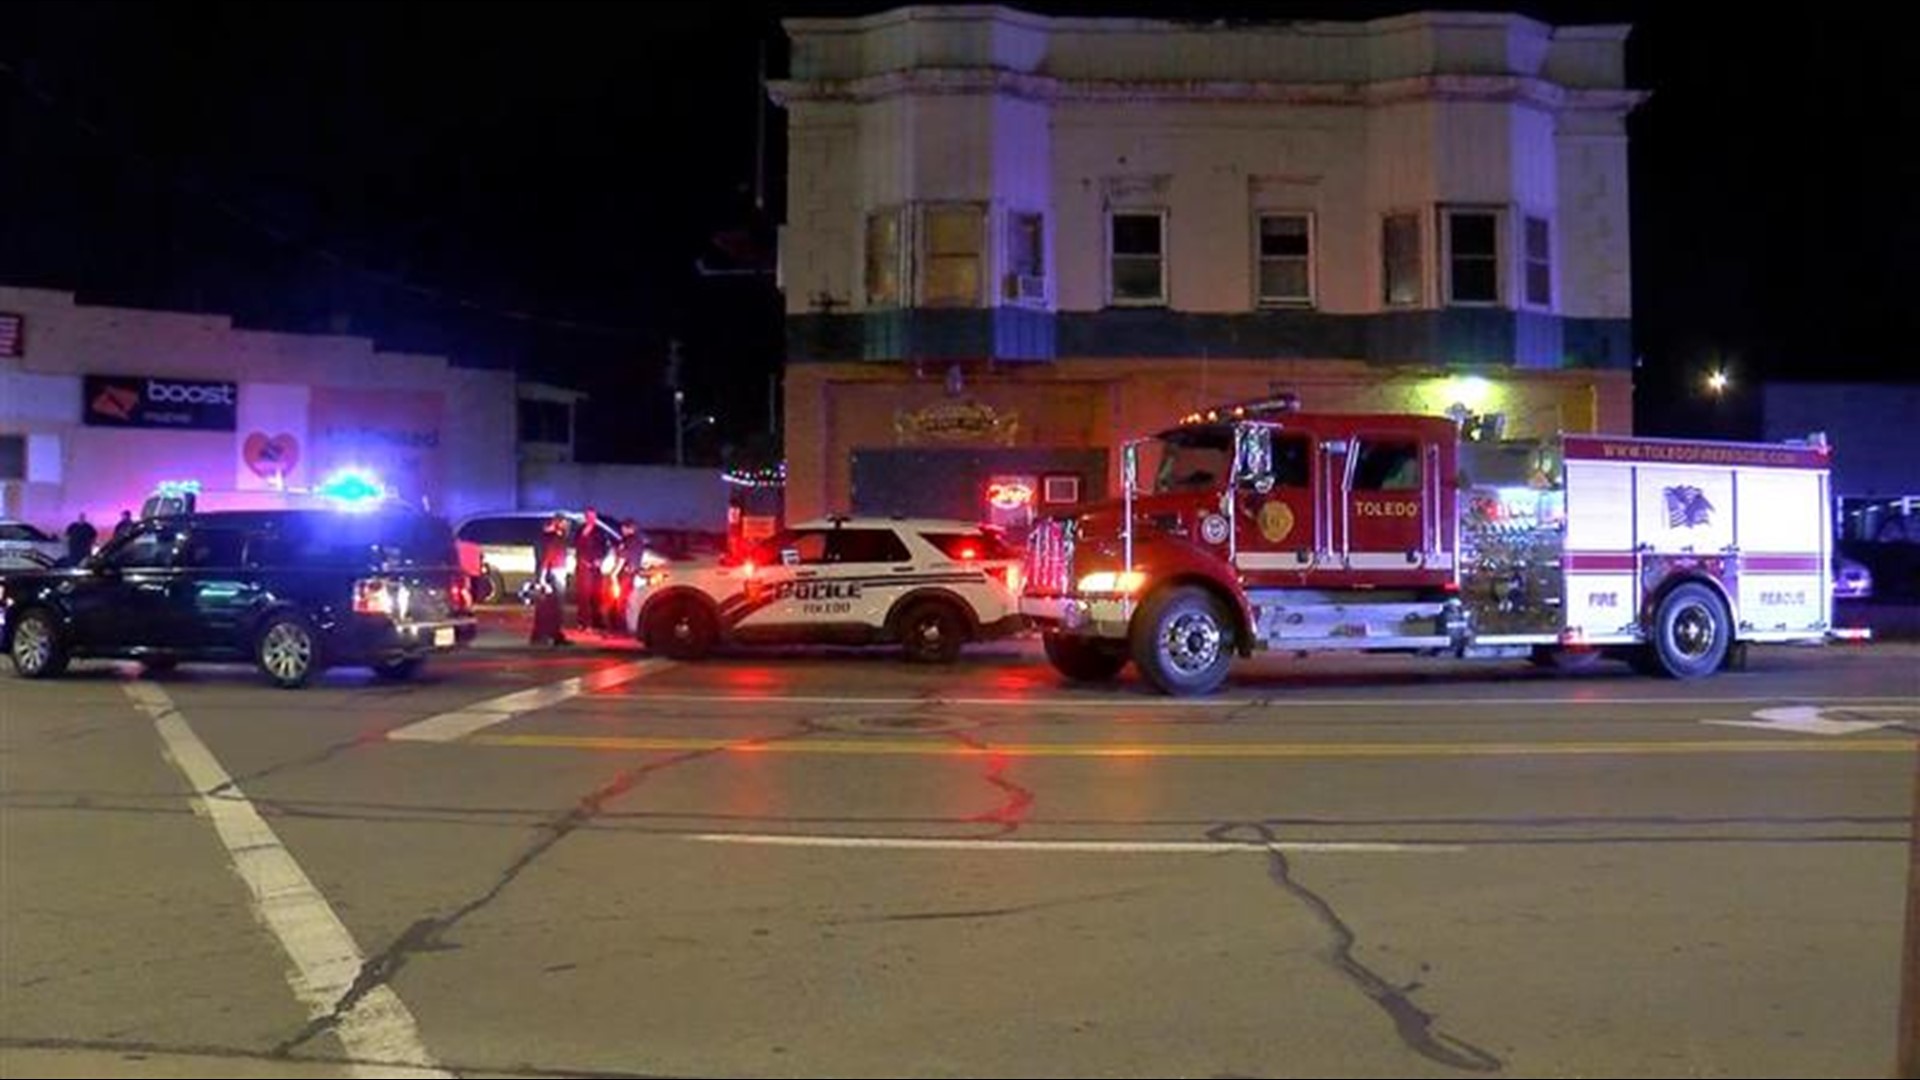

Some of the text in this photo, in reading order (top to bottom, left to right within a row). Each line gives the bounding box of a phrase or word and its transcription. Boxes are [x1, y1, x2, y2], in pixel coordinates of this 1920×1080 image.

[149, 380, 234, 405] boost
[1355, 502, 1418, 517] TOLEDO
[775, 581, 861, 599] POLICE
[1588, 591, 1618, 607] FIRE
